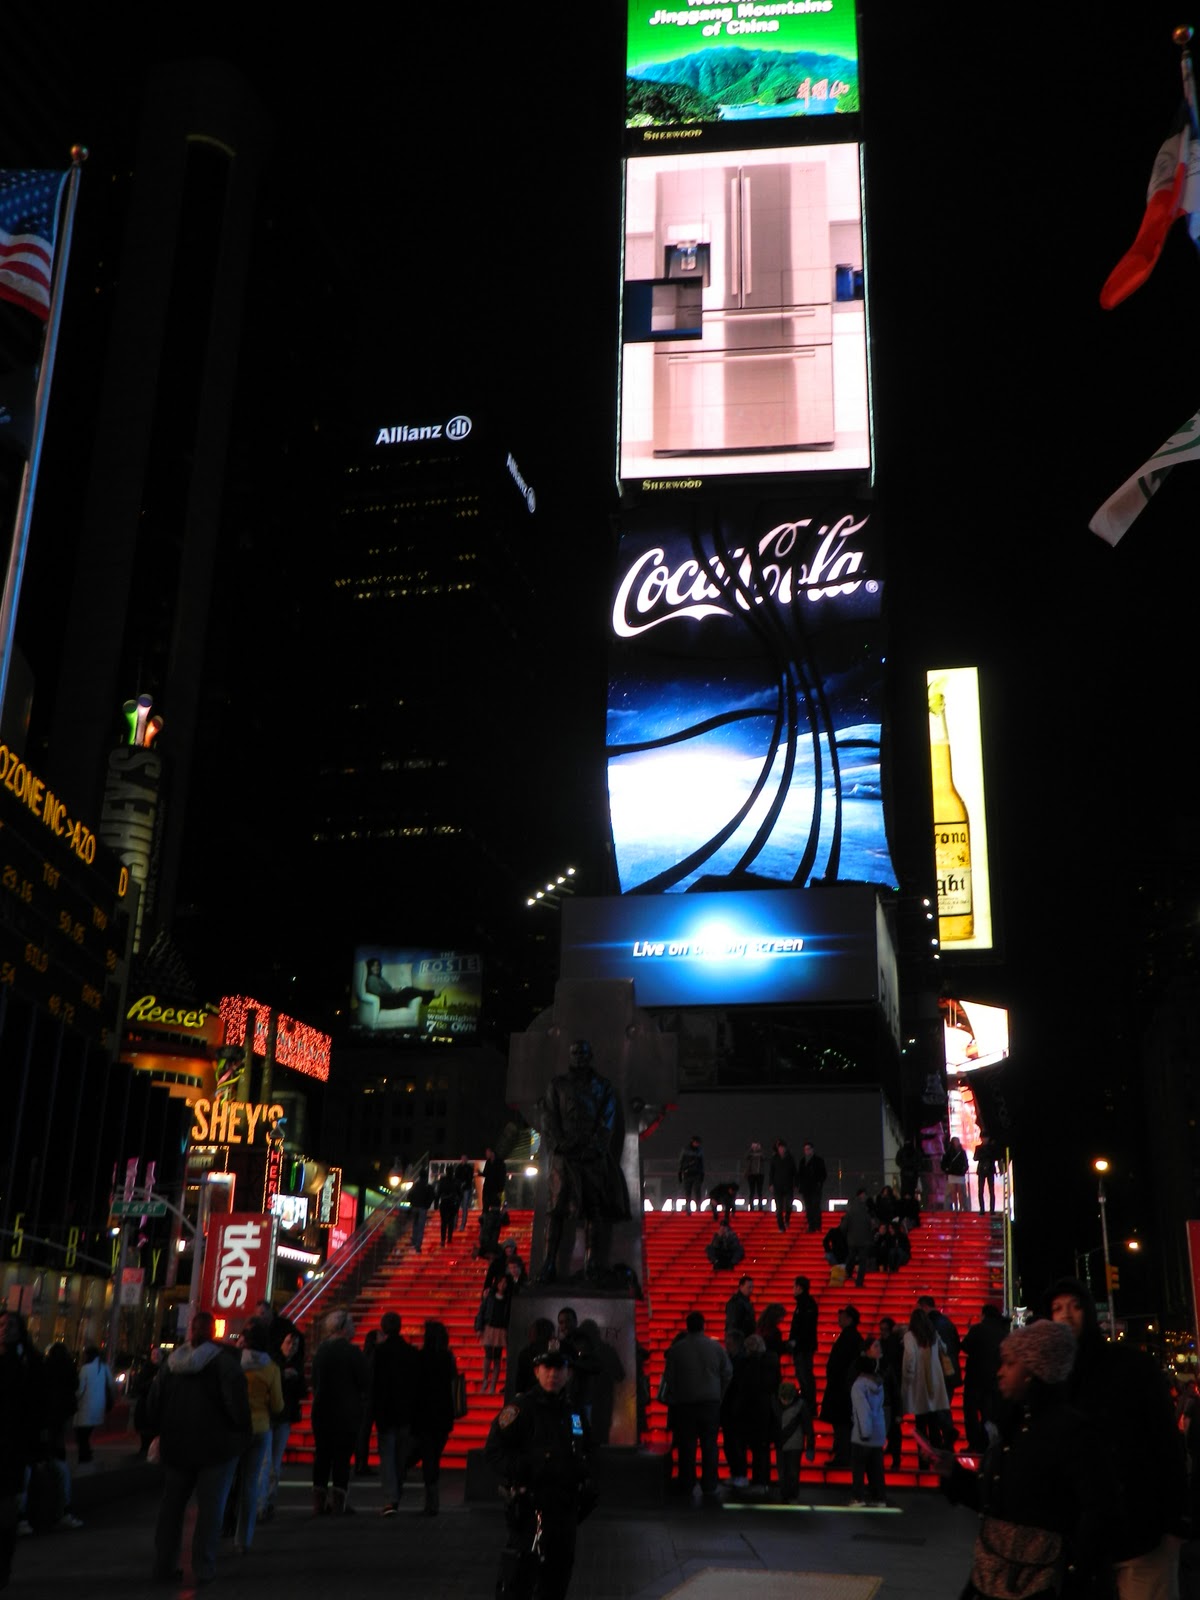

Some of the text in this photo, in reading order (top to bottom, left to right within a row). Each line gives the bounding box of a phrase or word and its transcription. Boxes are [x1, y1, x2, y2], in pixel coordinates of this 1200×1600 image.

[649, 0, 833, 26] Jinggang Mountains
[702, 19, 780, 37] of China
[375, 424, 443, 445] Allianz
[633, 940, 665, 957] Live
[668, 944, 690, 956] on
[754, 938, 803, 953] screen
[127, 995, 208, 1028] Reese's
[217, 1220, 262, 1309] tkts
